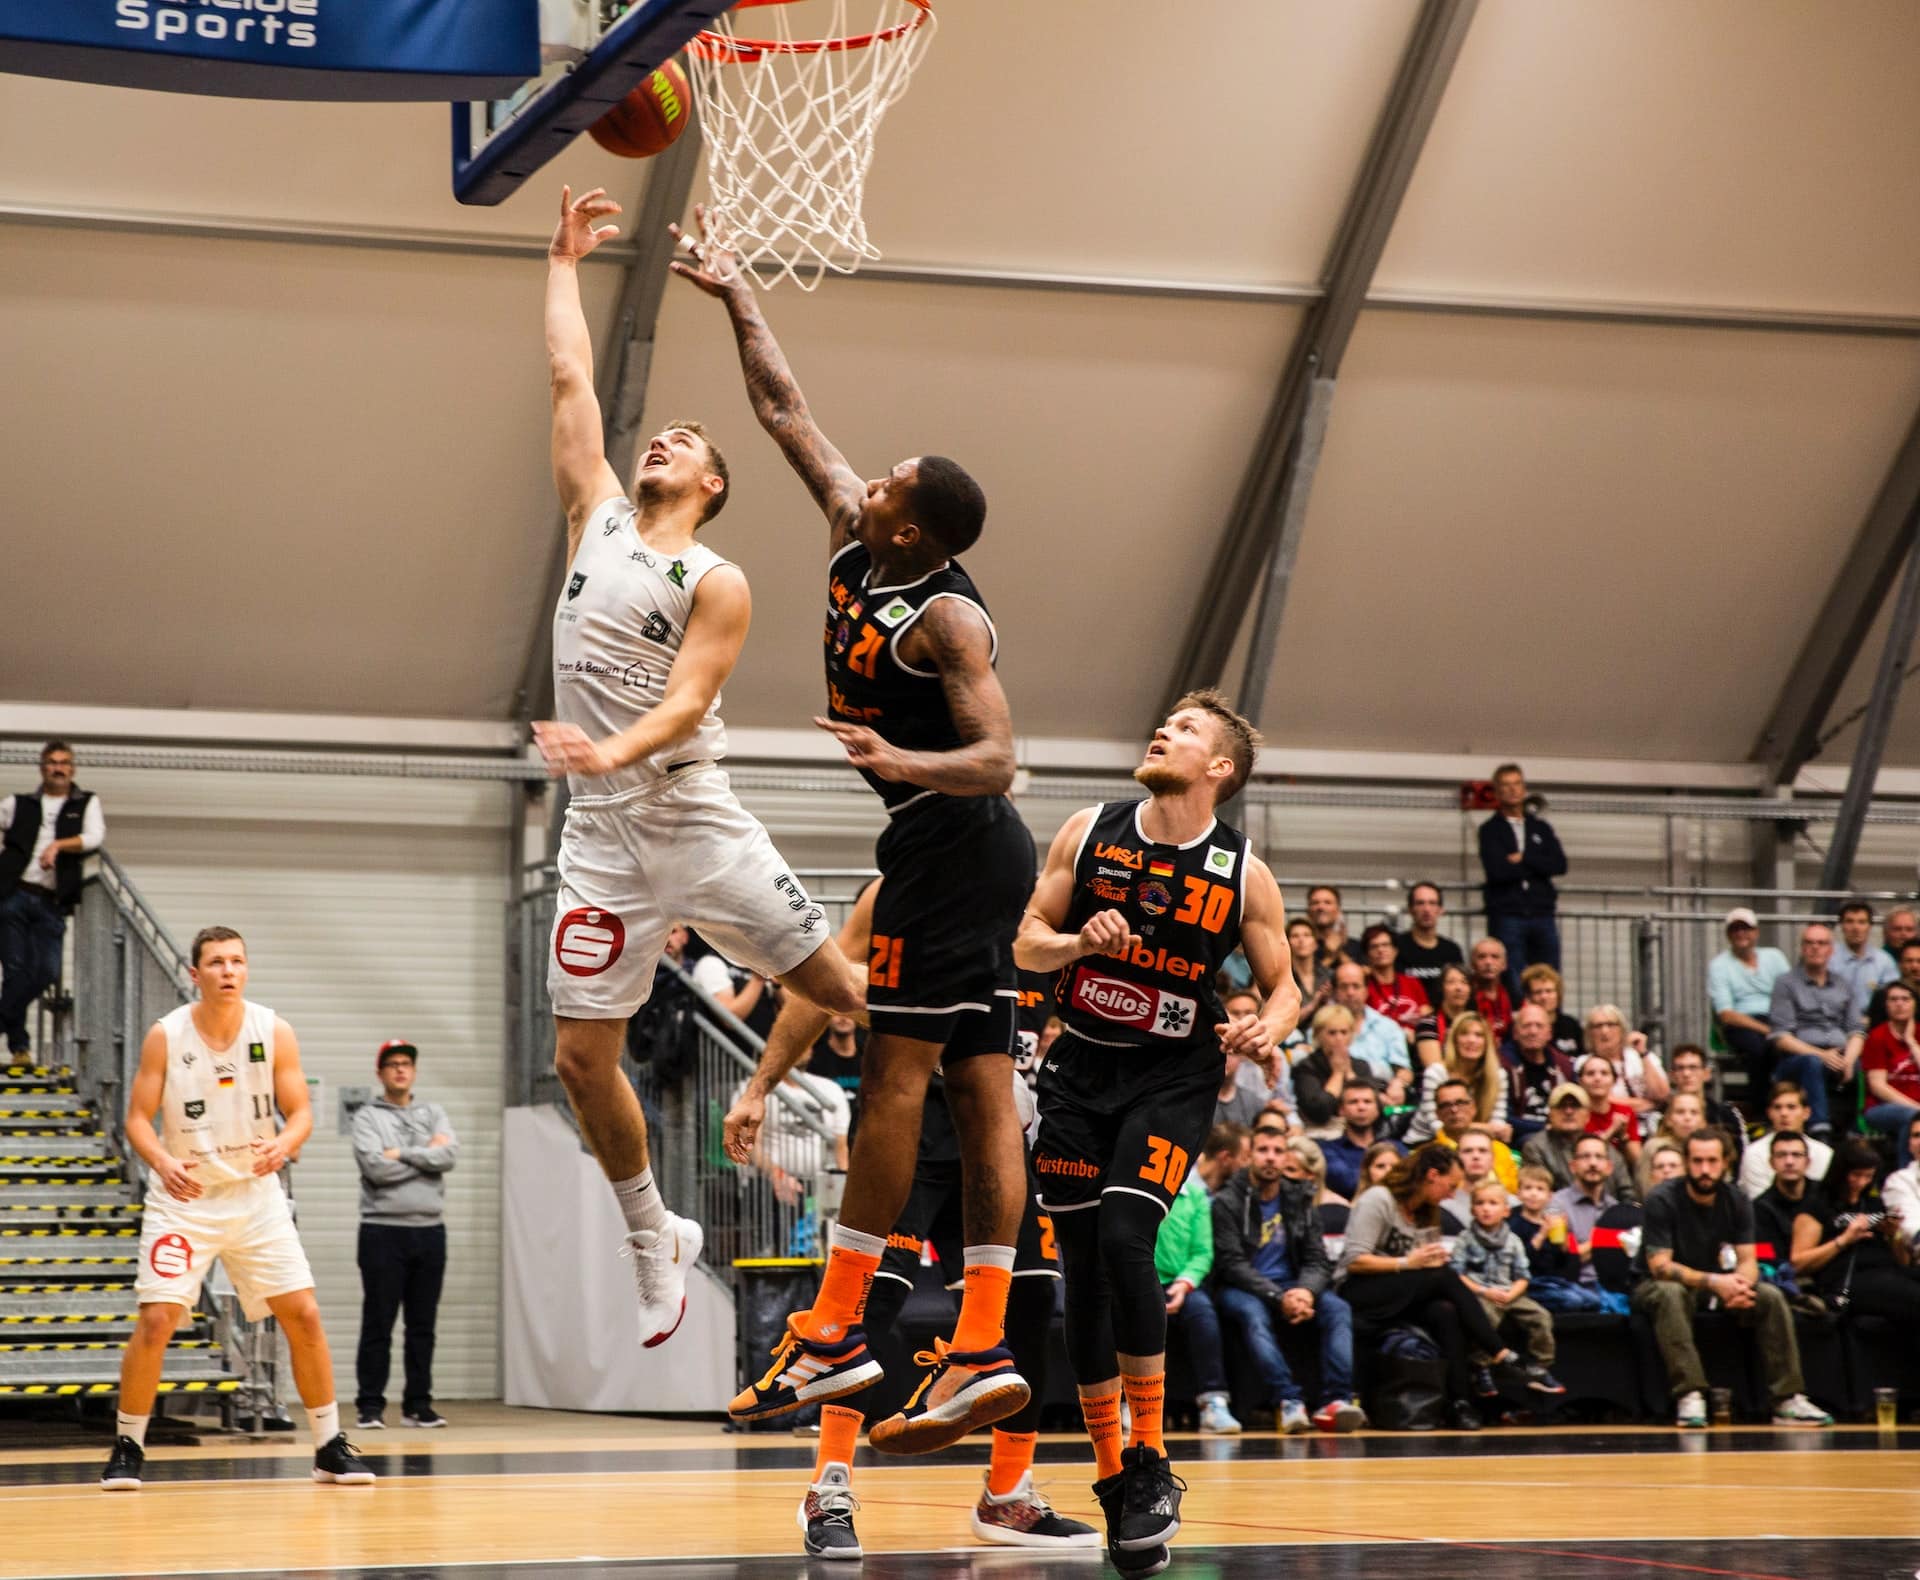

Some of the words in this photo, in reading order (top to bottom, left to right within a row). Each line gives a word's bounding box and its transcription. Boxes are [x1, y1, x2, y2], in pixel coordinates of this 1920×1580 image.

[848, 623, 886, 679] 21
[1097, 866, 1132, 880] SPALDING
[1174, 875, 1234, 934] 30
[869, 934, 904, 988] 21
[1079, 979, 1152, 1017] Helios
[252, 1094, 272, 1120] 11
[1139, 1135, 1188, 1196] 30
[1037, 1216, 1058, 1260] 2
